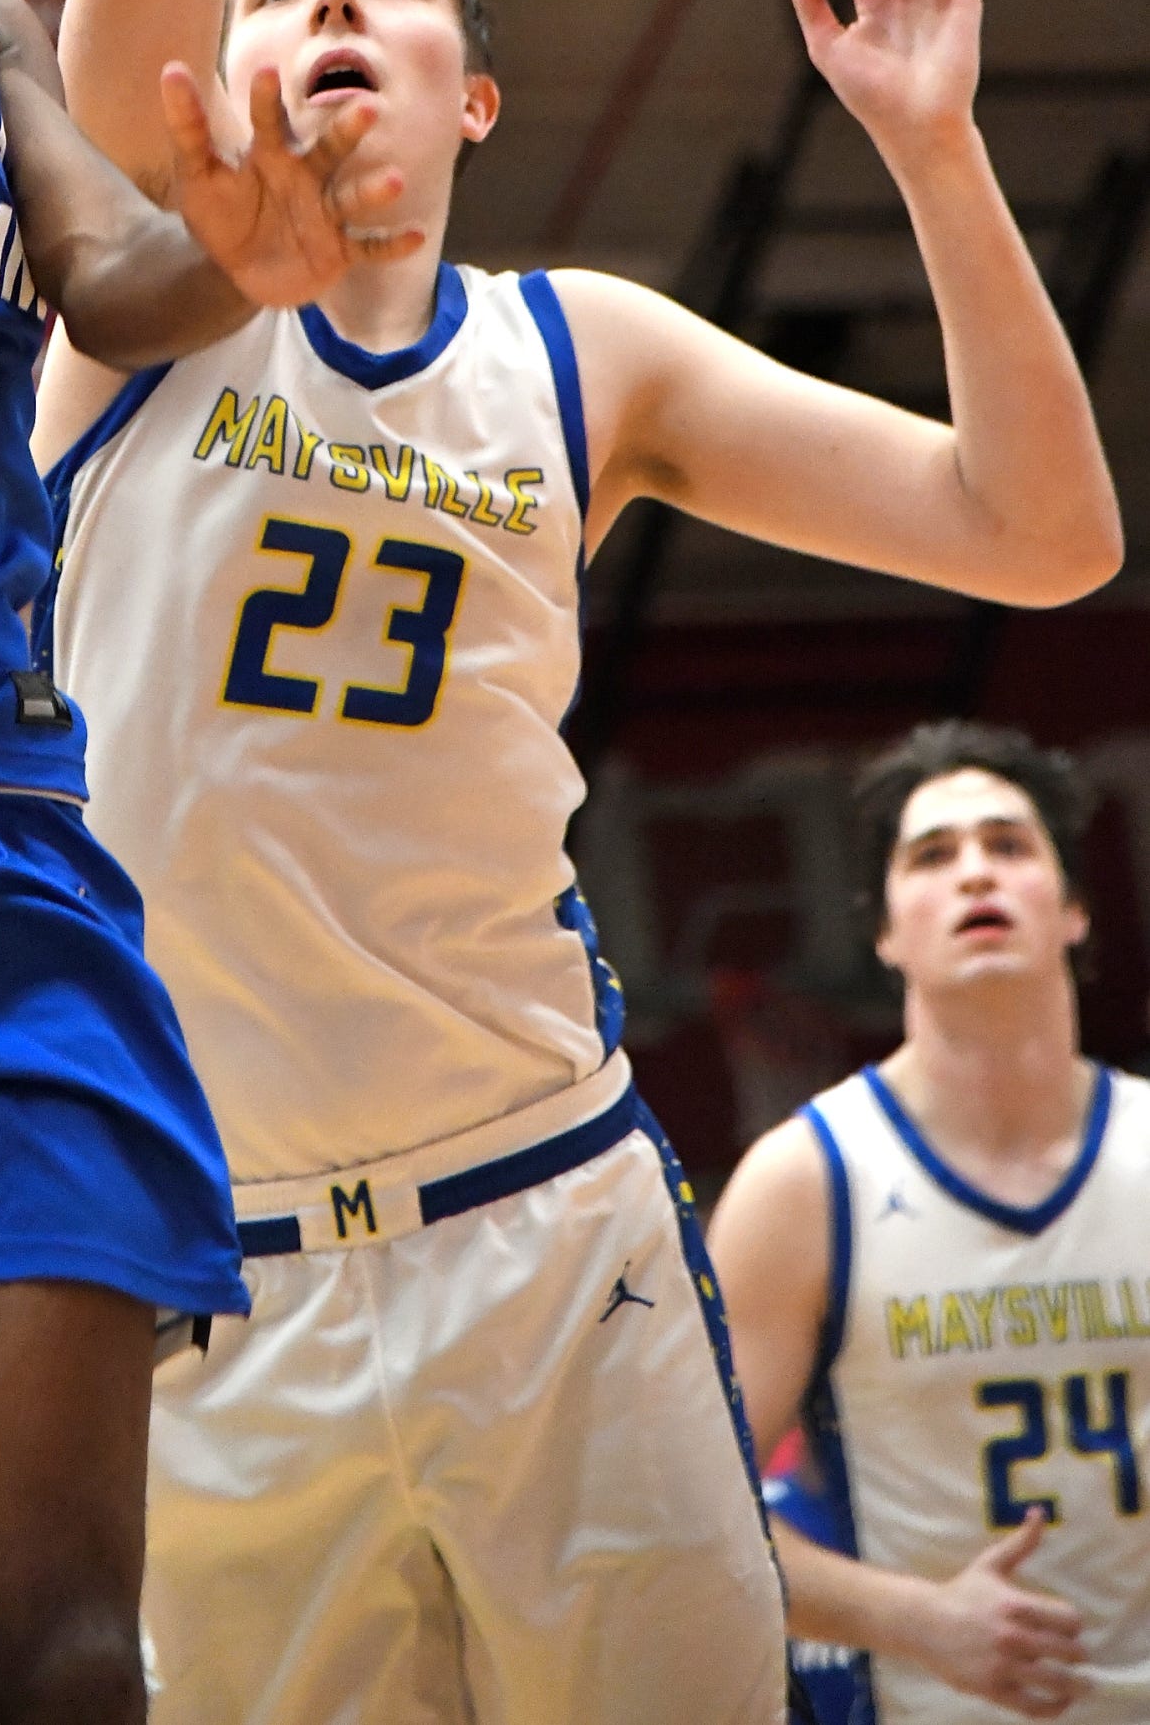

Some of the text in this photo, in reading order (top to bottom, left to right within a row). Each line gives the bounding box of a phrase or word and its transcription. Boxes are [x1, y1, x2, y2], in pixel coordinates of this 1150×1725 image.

[194, 387, 543, 535] MAYSVILLE
[218, 513, 470, 730] 23
[329, 1178, 378, 1241] M
[885, 1278, 1150, 1360] MAYSVILL
[972, 1366, 1143, 1532] 24
